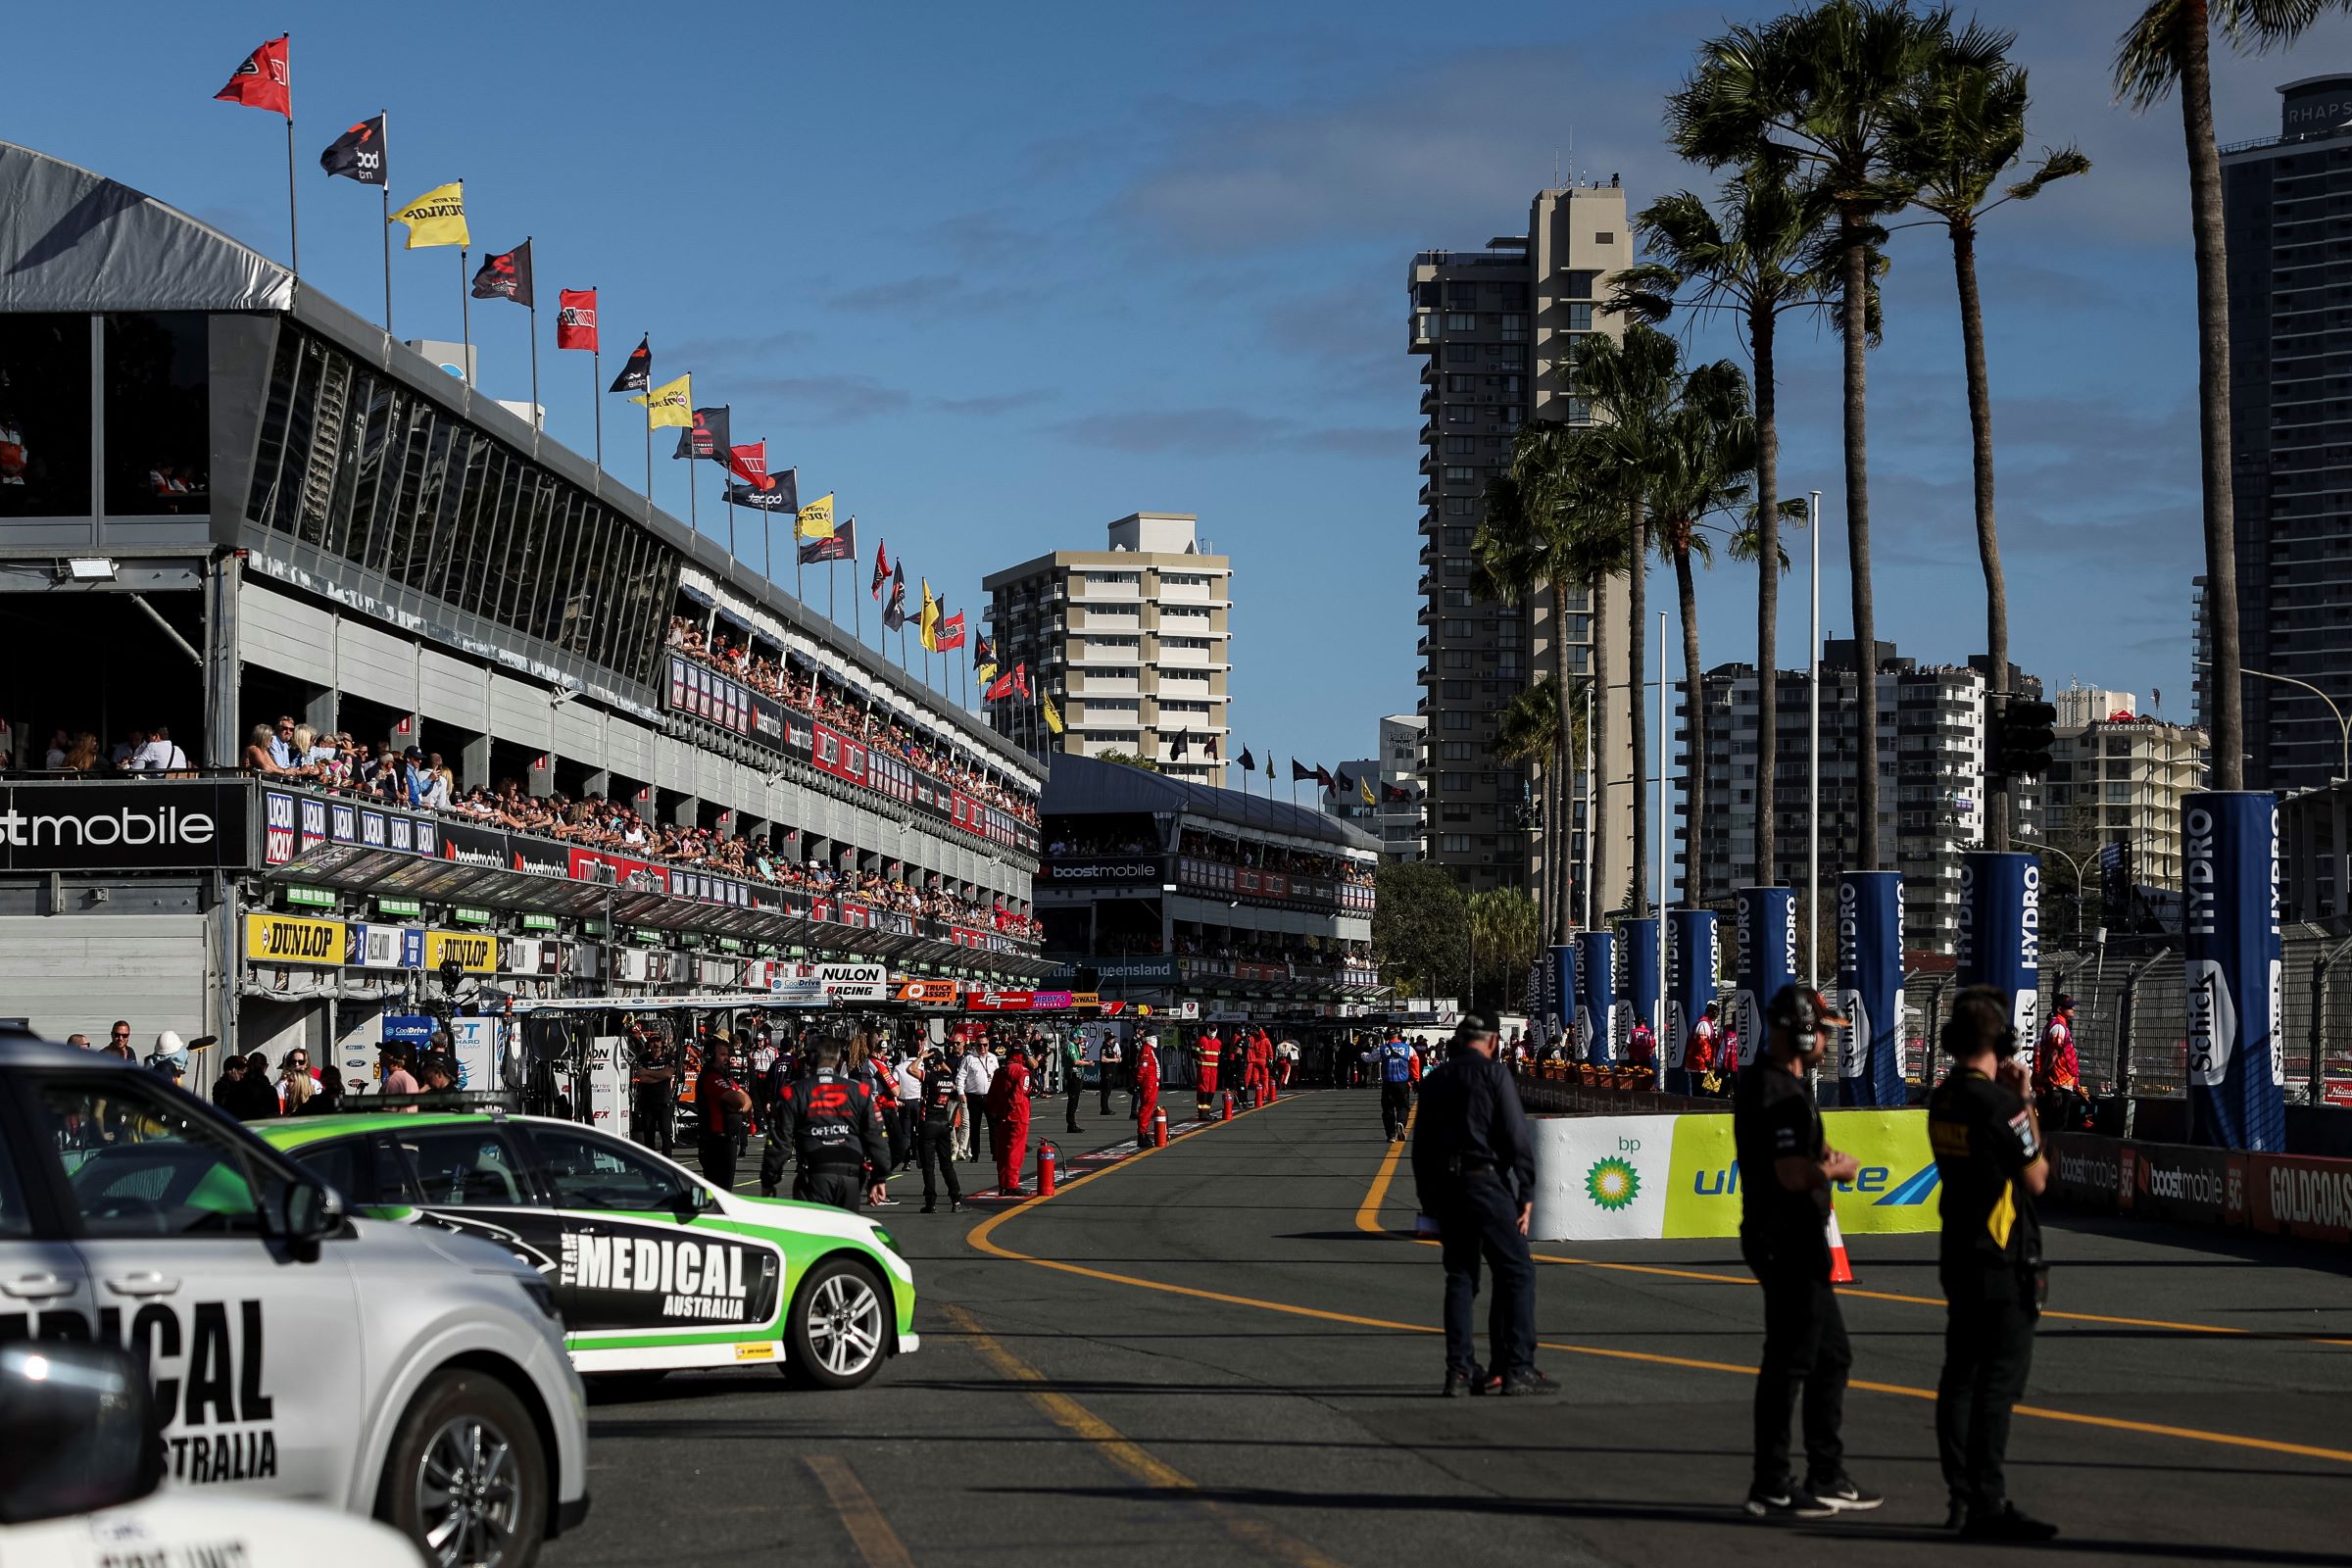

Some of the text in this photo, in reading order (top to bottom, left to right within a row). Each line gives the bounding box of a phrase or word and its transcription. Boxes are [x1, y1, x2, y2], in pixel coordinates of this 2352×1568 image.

[1388, 732, 1416, 741] Pacific
[269, 794, 293, 827] LIQUI
[302, 800, 324, 834] LIQUI
[333, 808, 354, 839] LIQUI
[268, 829, 293, 862] MOLY
[364, 812, 384, 845] LIQUI
[391, 819, 410, 850] LIQUI
[417, 824, 434, 854] LIQUI
[1053, 863, 1155, 877] boostmobile
[2187, 808, 2215, 934] HYDRO
[1839, 882, 1856, 971] HYDRO
[1958, 864, 1974, 966] HYDRO
[2022, 865, 2038, 969] HYDRO
[270, 922, 332, 957] DUNLOP
[1667, 918, 1678, 987] HYDRO
[1738, 897, 1749, 974] HYDRO
[1787, 896, 1796, 974] HYDRO
[444, 939, 488, 967] DUNLOP
[1098, 963, 1170, 977] ueensland
[1576, 939, 1585, 995] HYDRO
[1619, 927, 1628, 988] HYDRO
[784, 979, 820, 988] CoolDrive
[821, 968, 880, 982] NULON
[827, 986, 873, 997] RACING
[1547, 953, 1556, 1004] HYDRO
[1739, 998, 1749, 1058] Schick
[2022, 1001, 2035, 1073] chick
[2190, 971, 2216, 1072] Schick
[1619, 1136, 1641, 1152] bp
[2061, 1152, 2118, 1191] boostmobile
[2121, 1168, 2133, 1198] 5G
[2150, 1162, 2223, 1204] boostmobile
[2228, 1176, 2242, 1211] 5G
[561, 1233, 578, 1286] TEAM
[576, 1234, 747, 1298] MEDICAL
[662, 1294, 744, 1320] AUSTRALIA
